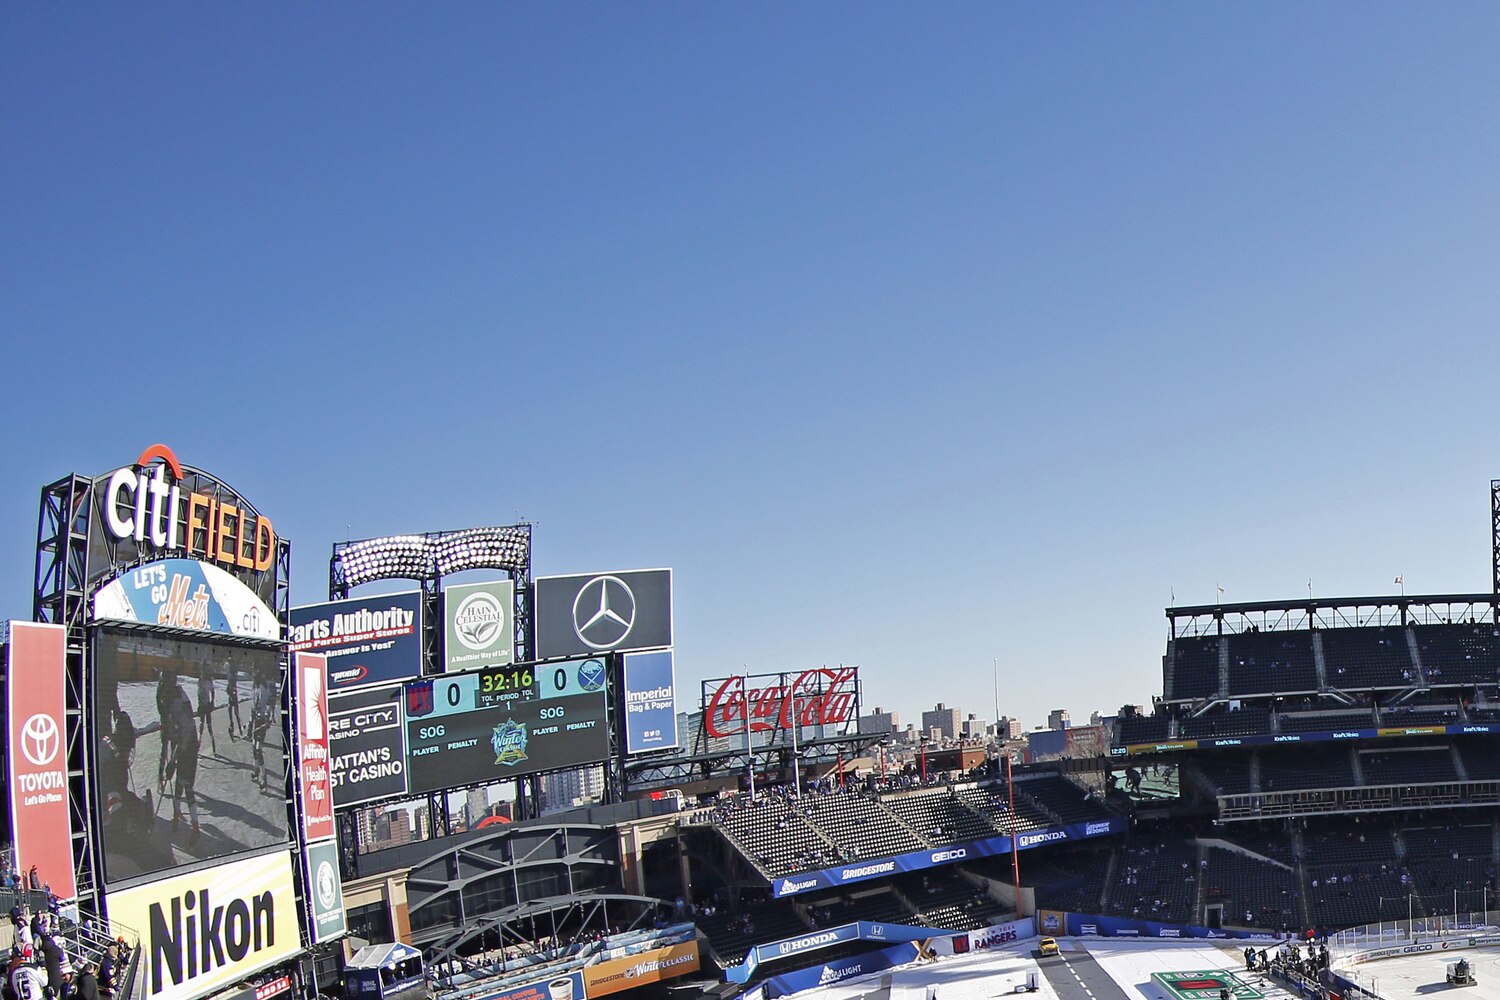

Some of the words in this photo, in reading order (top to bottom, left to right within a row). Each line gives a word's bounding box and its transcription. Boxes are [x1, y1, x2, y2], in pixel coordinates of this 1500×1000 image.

[186, 492, 275, 571] FIELD
[133, 563, 167, 590] LET'S
[151, 585, 168, 605] GO
[157, 573, 211, 631] Mets
[456, 611, 502, 626] CELESTIAL
[468, 606, 491, 616] HAIN
[289, 619, 330, 643] Parts
[332, 606, 414, 637] Authority
[289, 642, 312, 651] Auto
[314, 638, 341, 647] Parts
[343, 632, 375, 643] Super
[375, 627, 410, 637] Stores
[325, 646, 361, 657] Answer
[456, 654, 480, 662] Healthier
[480, 652, 492, 660] Way
[482, 669, 533, 693] 32:16
[553, 668, 567, 691] 0
[447, 682, 460, 706] 0
[496, 692, 520, 702] PERIOD
[522, 689, 534, 697] TOL
[627, 686, 673, 703] Imperial
[506, 701, 511, 711] 1
[540, 706, 565, 720] SOG
[628, 703, 643, 713] Bag
[644, 702, 650, 711] &
[651, 700, 673, 711] Paper
[329, 729, 360, 740] ASINO
[420, 725, 446, 740] SOG
[533, 725, 559, 736] PLAYER
[566, 720, 596, 732] PENALTY
[303, 744, 328, 762] Affinity
[413, 746, 440, 757] PLAYER
[447, 739, 479, 750] PENALTY
[305, 765, 328, 783] Health
[349, 761, 402, 783] CASINO
[18, 771, 65, 793] TOYOTA
[24, 795, 38, 806] Let's
[38, 794, 46, 804] Go
[46, 793, 62, 803] Places
[311, 784, 325, 800] Plan
[1029, 831, 1067, 844] HONDA
[931, 849, 966, 863] GEICO
[842, 862, 894, 880] BRIDGESTONE
[800, 879, 818, 890] LIGHT
[149, 888, 275, 995] Nikon
[792, 932, 838, 951] HONDA
[974, 930, 1017, 949] RANGERS
[1403, 944, 1432, 954] GEICO
[634, 959, 667, 977] Winter
[666, 953, 694, 967] CLASSIC
[842, 965, 862, 976] LIGHT
[16, 980, 31, 1000] 15
